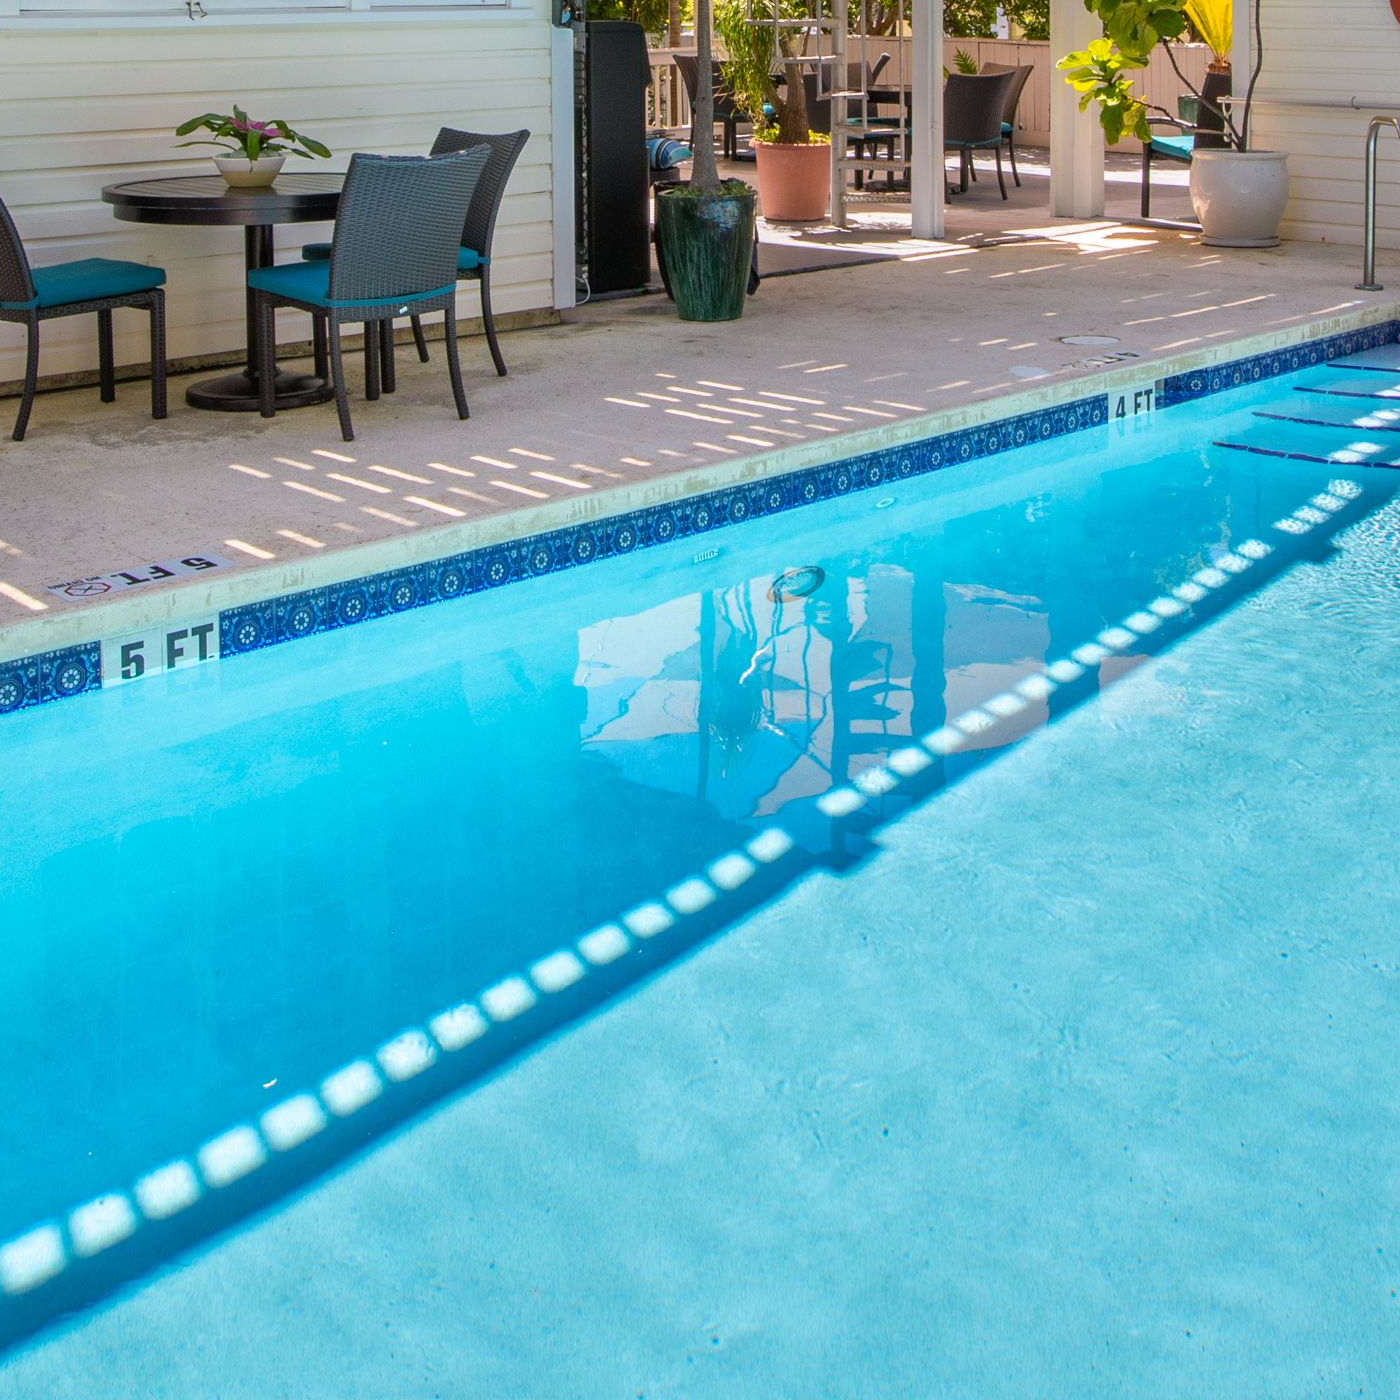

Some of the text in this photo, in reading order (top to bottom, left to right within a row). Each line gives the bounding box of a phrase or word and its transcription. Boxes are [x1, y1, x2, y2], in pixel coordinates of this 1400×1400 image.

[1115, 396, 1126, 419] 4
[180, 557, 218, 571] 5
[121, 640, 145, 680] 5
